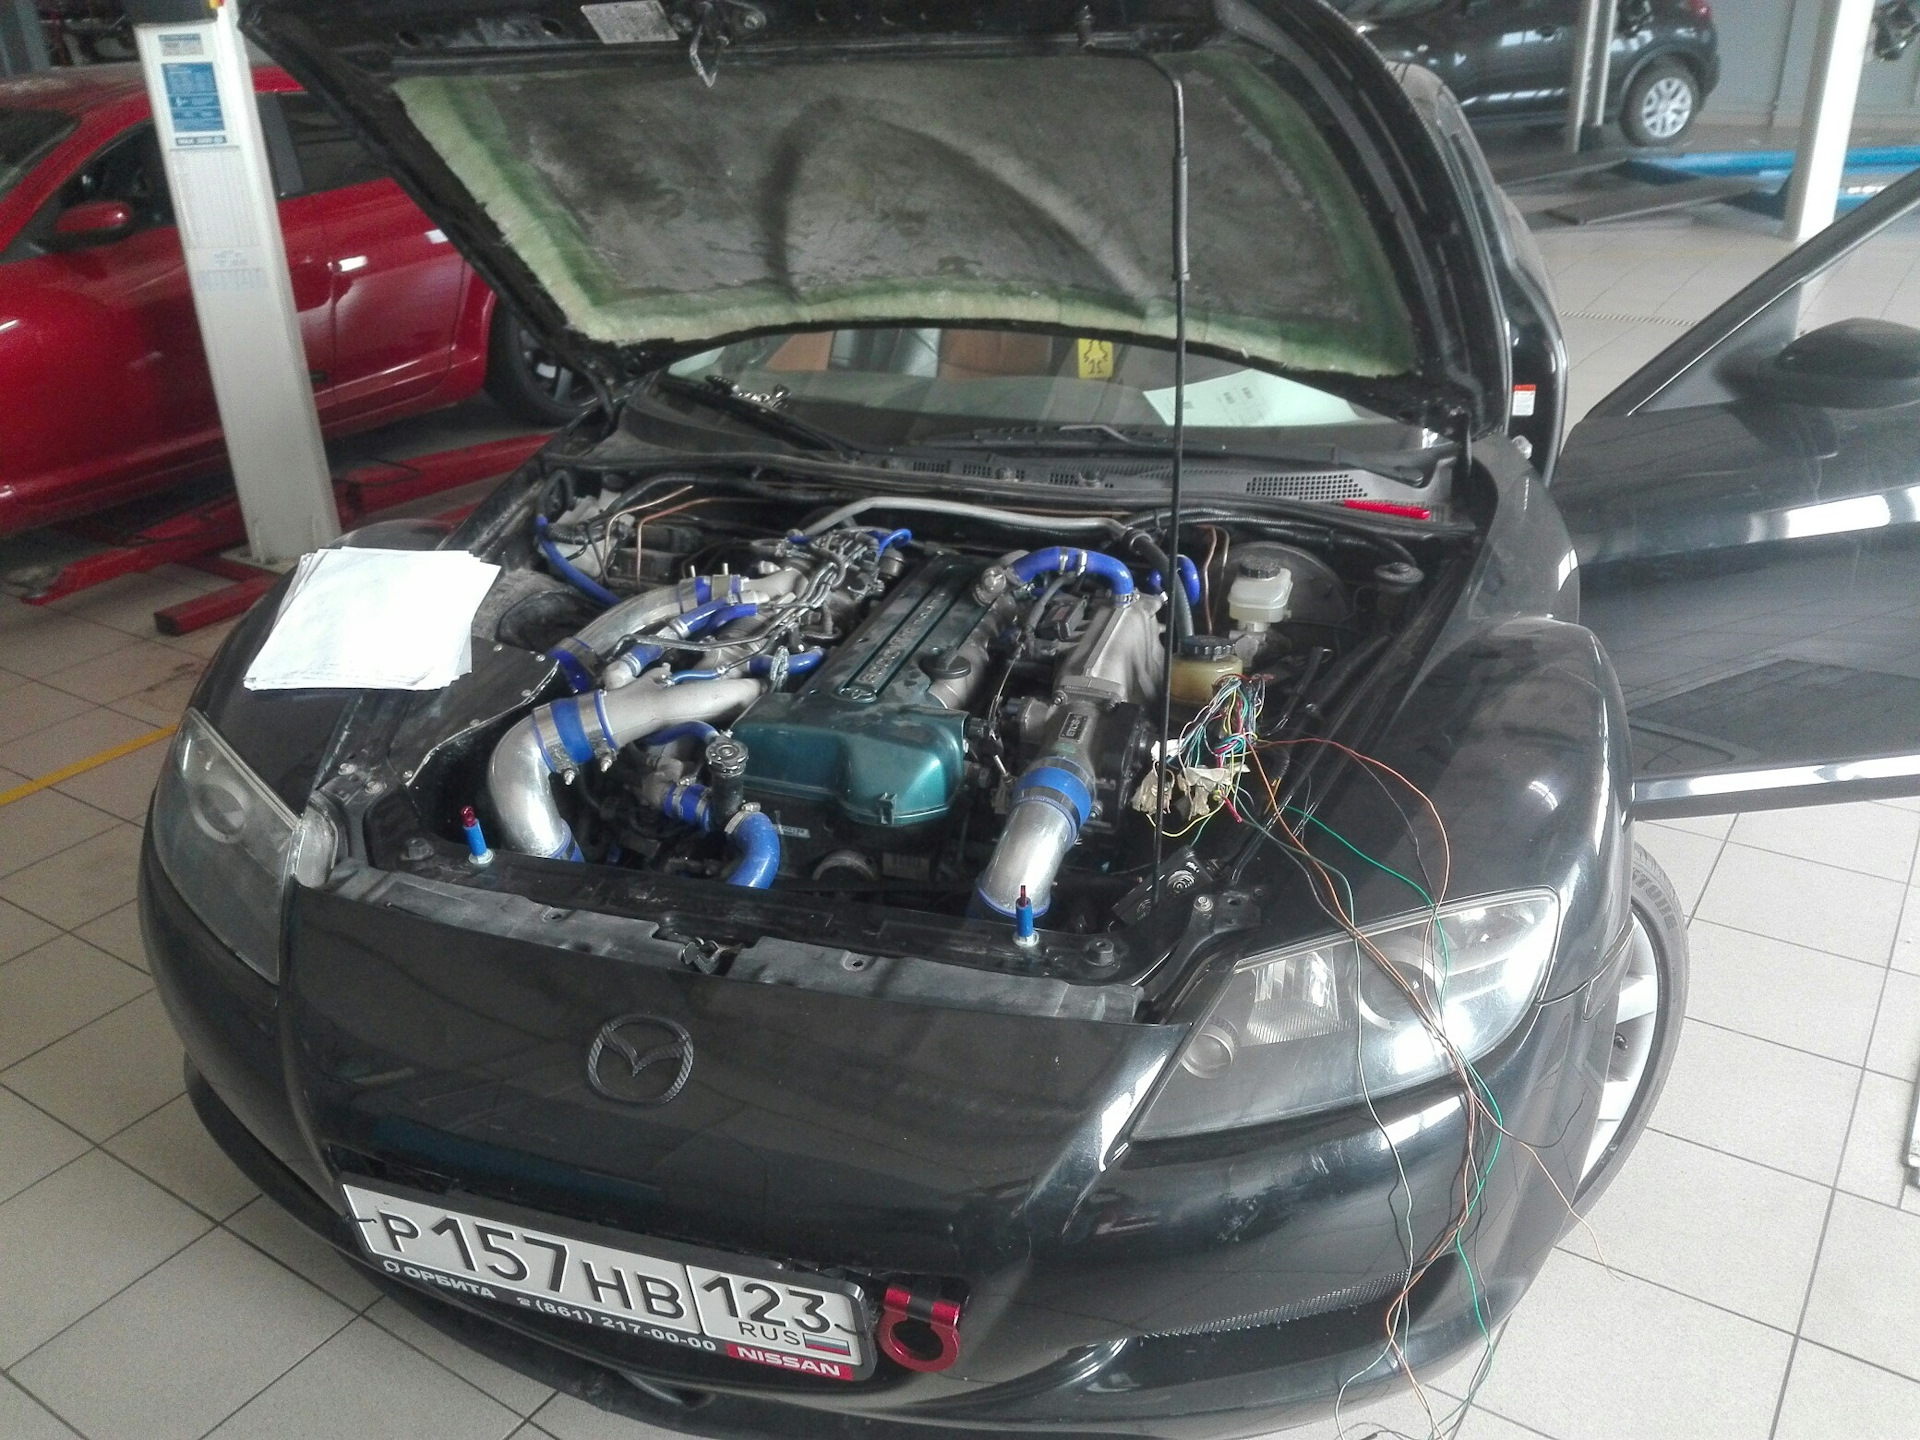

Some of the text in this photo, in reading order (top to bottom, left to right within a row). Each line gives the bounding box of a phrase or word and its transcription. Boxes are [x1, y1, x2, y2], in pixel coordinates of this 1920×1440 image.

[403, 1266, 717, 1352] ОРБИТА (861) 217-00-00
[702, 1273, 831, 1334] 123
[738, 1320, 801, 1346] RUS
[736, 1346, 841, 1377] NISSAN
